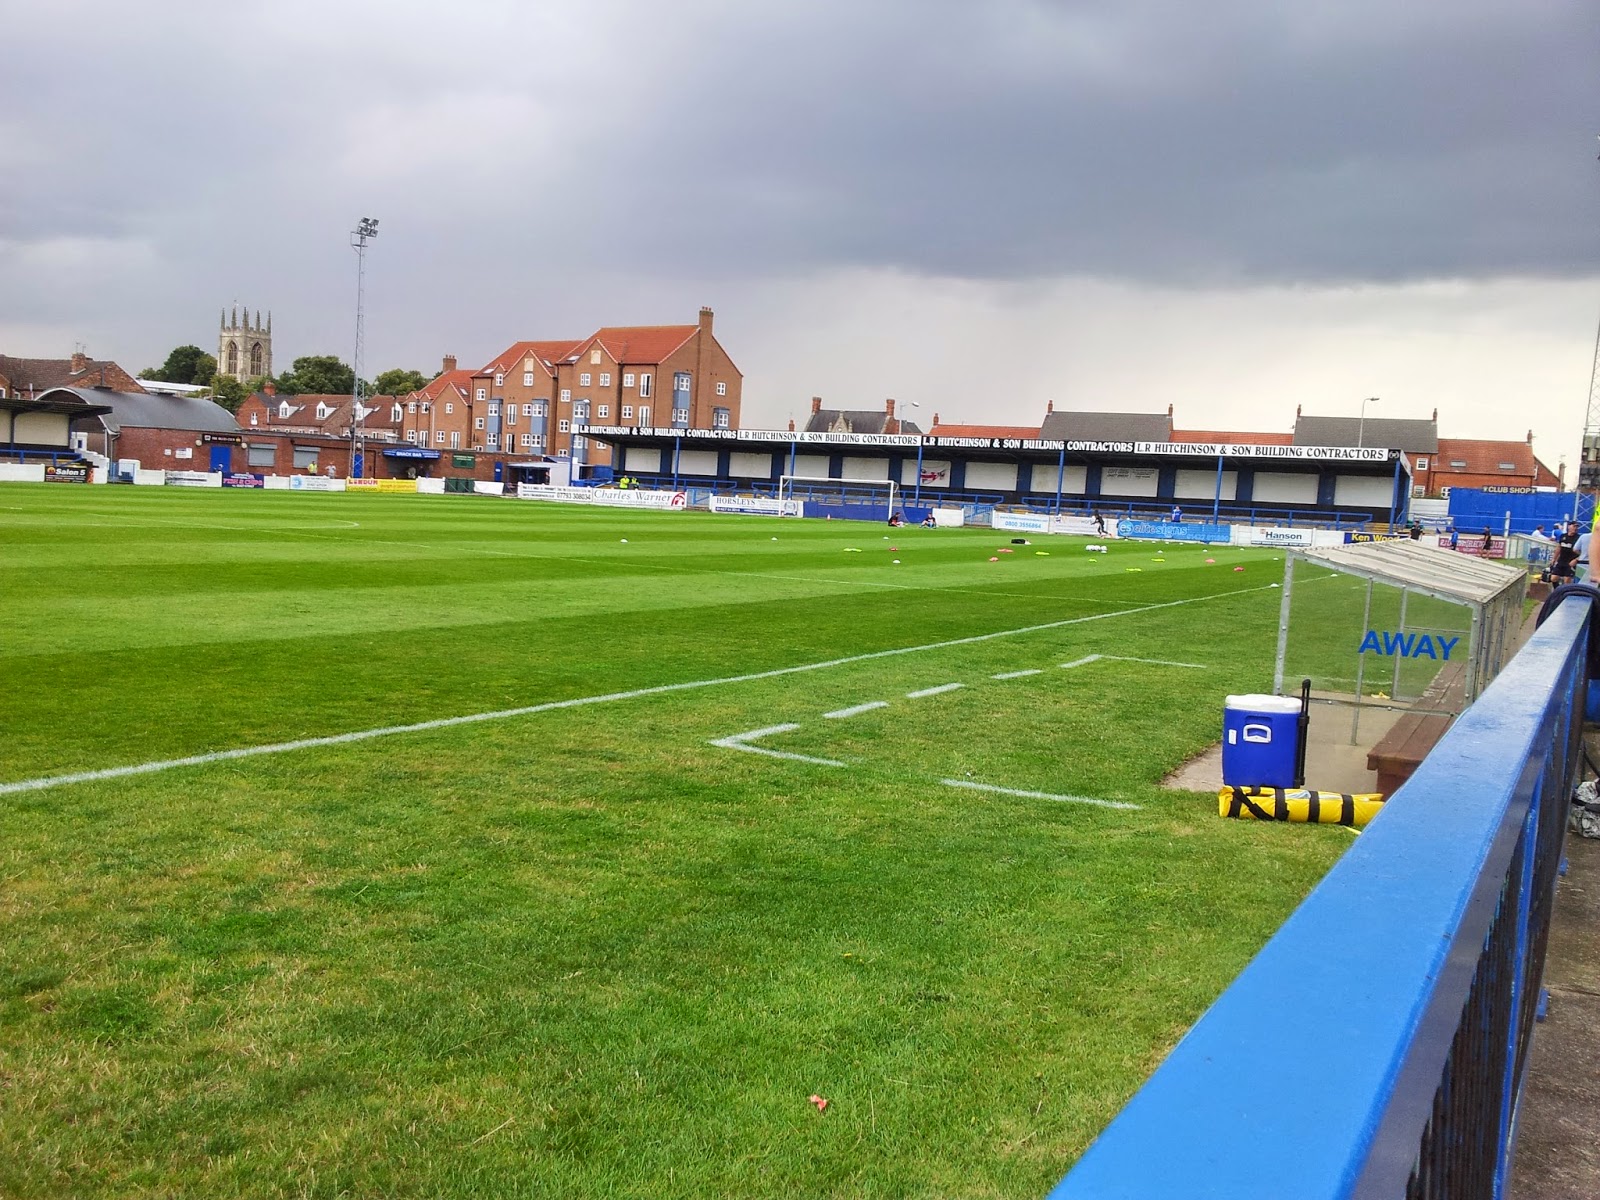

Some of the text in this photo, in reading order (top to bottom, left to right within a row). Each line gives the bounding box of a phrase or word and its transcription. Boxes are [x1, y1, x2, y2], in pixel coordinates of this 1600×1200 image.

[590, 426, 630, 435] HUTCHINSON
[632, 427, 638, 436] &
[640, 427, 653, 436] SON
[654, 428, 685, 437] BUILDING
[686, 429, 736, 439] CONTRACTORS
[751, 432, 797, 441] HUTCHINSON
[799, 433, 805, 441] &
[808, 433, 823, 442] SON
[825, 434, 860, 443] BUILDING
[862, 435, 918, 445] CONTRACTORS
[937, 437, 991, 448] HUTCHINSON
[992, 439, 1001, 448] &
[1003, 439, 1021, 449] SON
[1023, 440, 1065, 450] BUILDING
[1066, 441, 1133, 452] CONTRACTORS
[1154, 444, 1217, 454] HUTCHINSON
[1219, 445, 1228, 455] &
[1231, 446, 1251, 455] SON
[1255, 446, 1303, 457] BUILDING
[1306, 448, 1385, 459] CONTRACTORS
[55, 468, 79, 476] Salon
[593, 489, 631, 500] Charles
[635, 491, 672, 502] Warner
[716, 497, 756, 505] HORSLEYS
[1265, 531, 1302, 540] Hanson
[1351, 533, 1370, 541] Ken
[1358, 630, 1461, 661] AWAY
